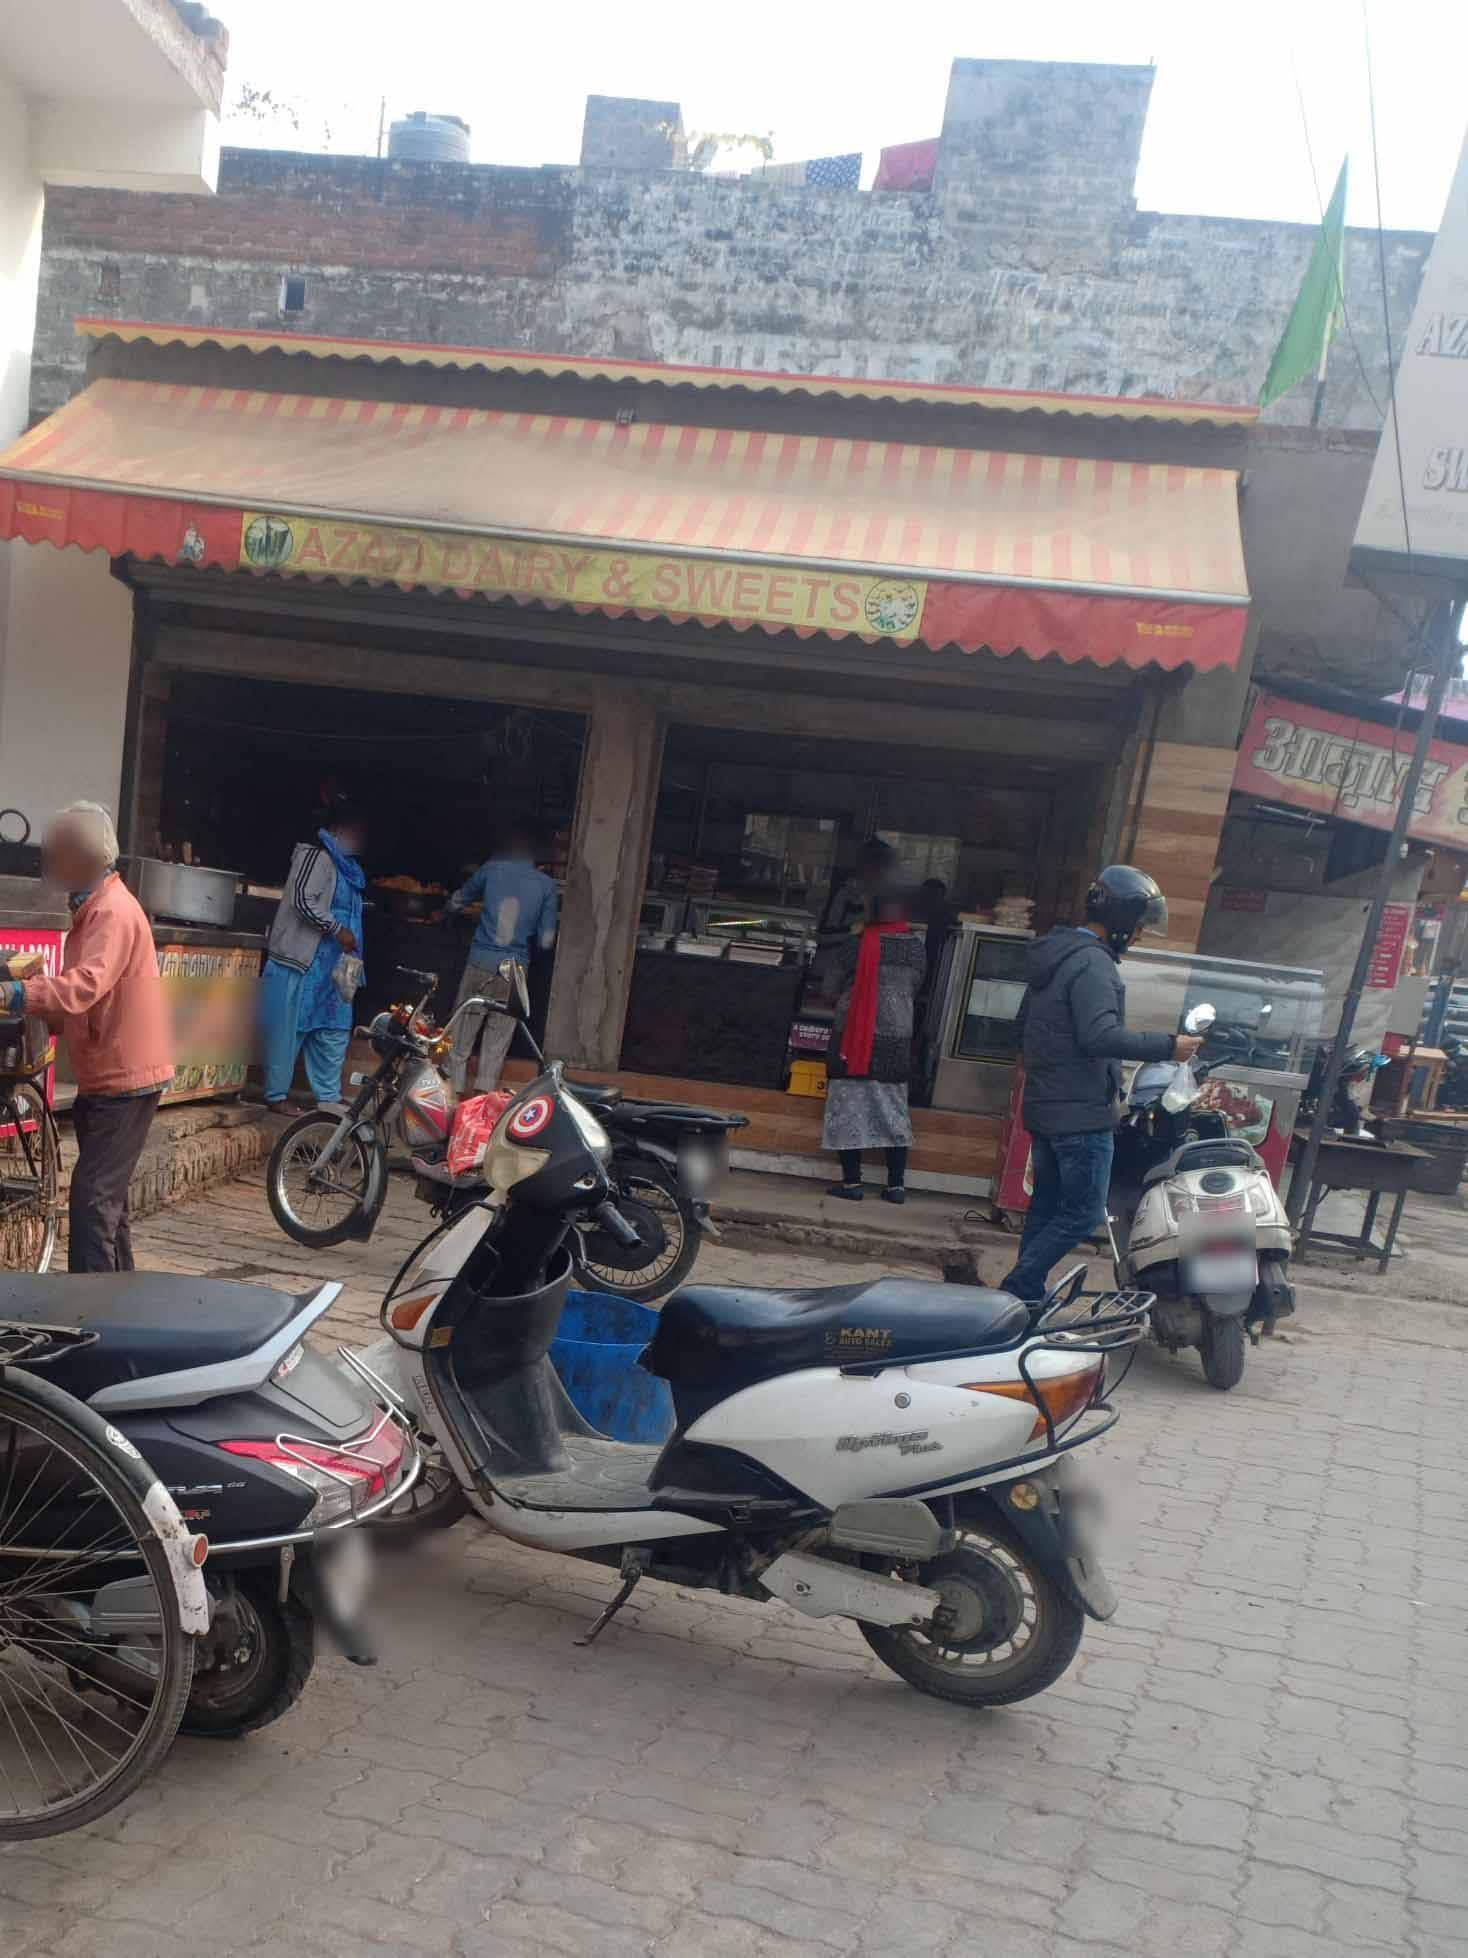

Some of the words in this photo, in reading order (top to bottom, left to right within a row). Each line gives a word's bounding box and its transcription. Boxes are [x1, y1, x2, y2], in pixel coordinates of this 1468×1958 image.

[296, 527, 425, 577] AZAD
[441, 543, 592, 593] DAIRY
[602, 559, 643, 598] &
[652, 563, 861, 623] SWEETS
[840, 1327, 893, 1338] KANT
